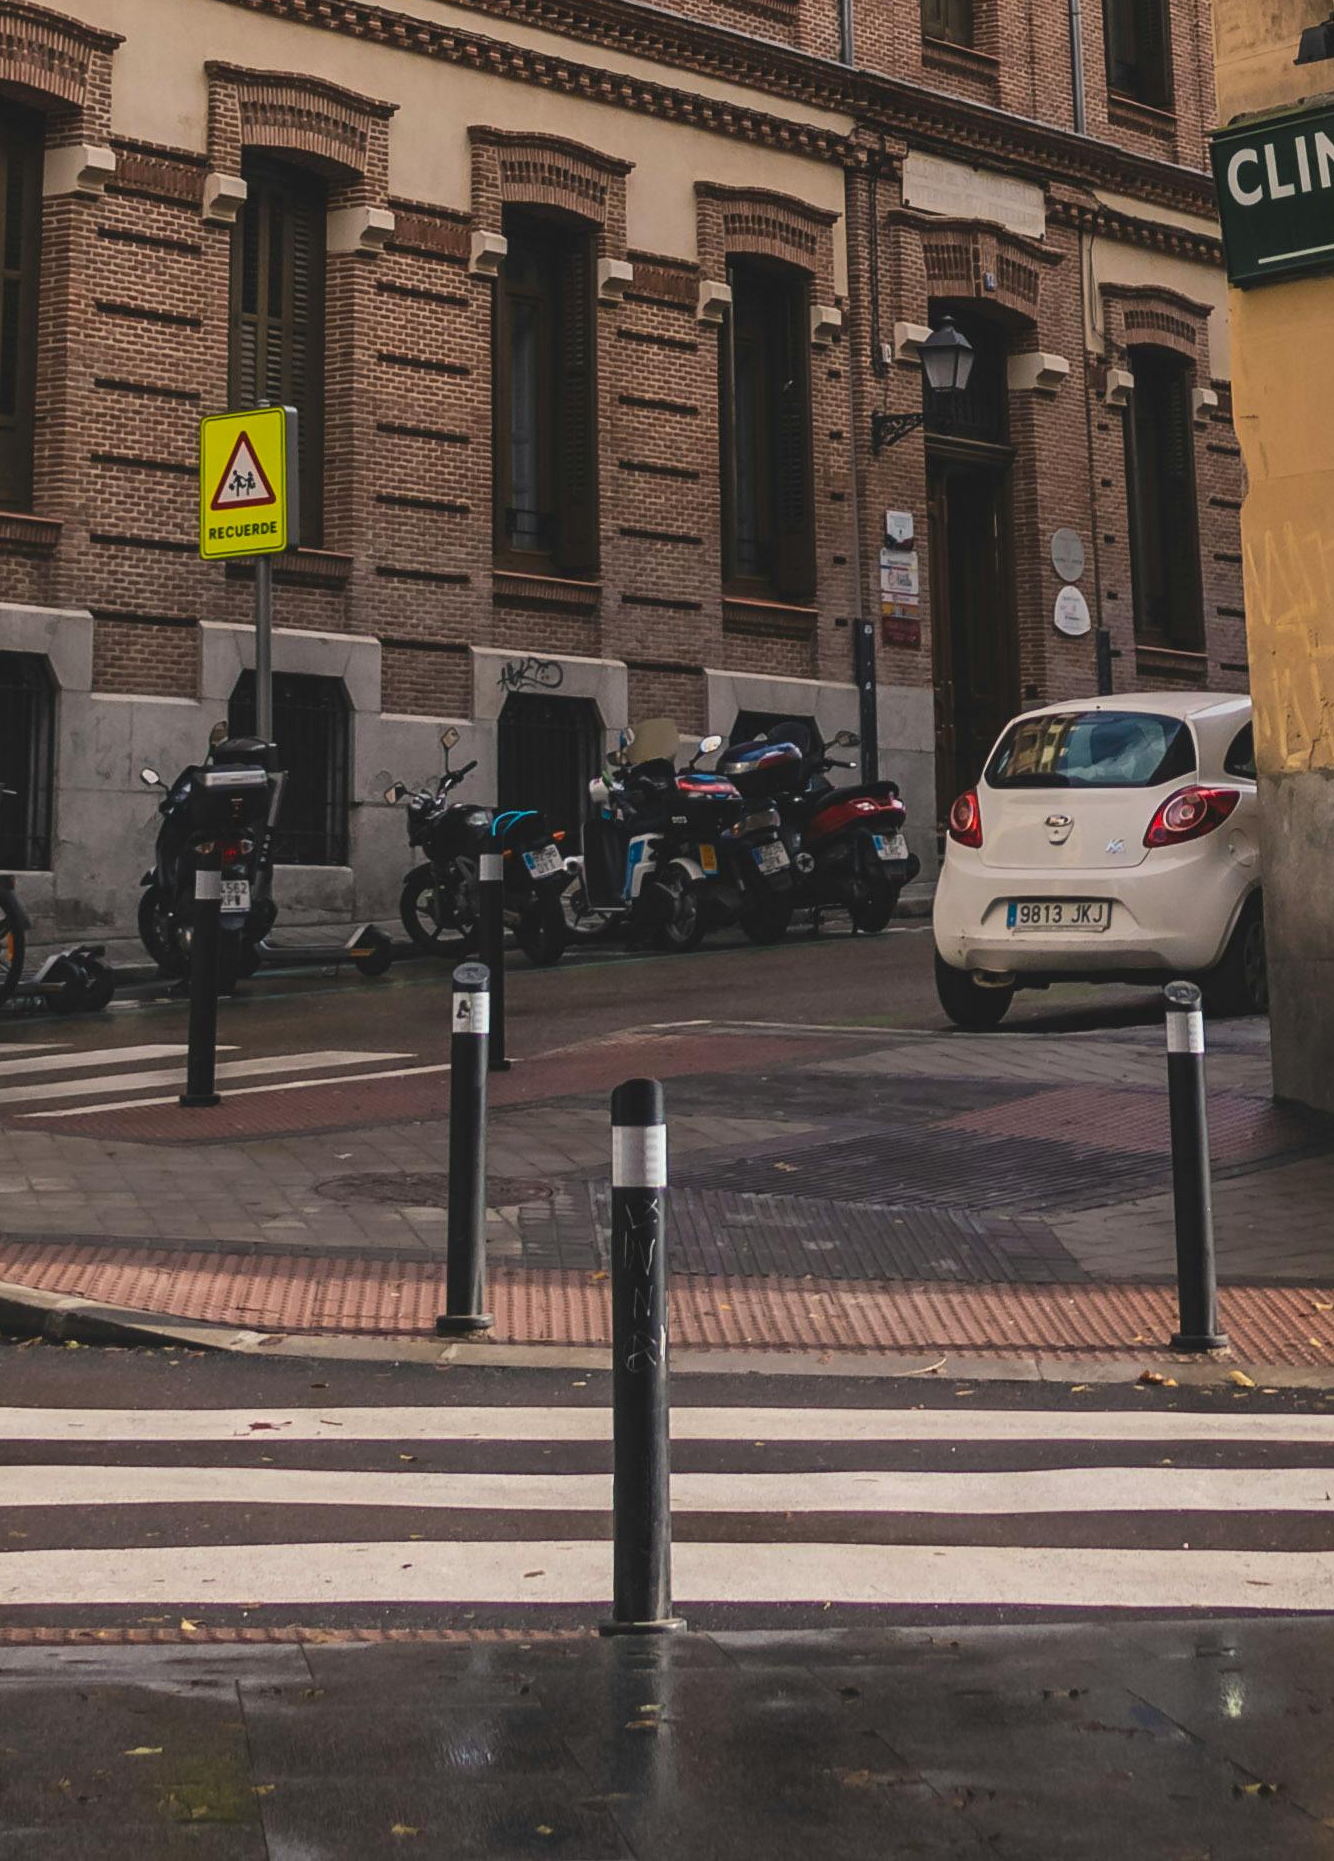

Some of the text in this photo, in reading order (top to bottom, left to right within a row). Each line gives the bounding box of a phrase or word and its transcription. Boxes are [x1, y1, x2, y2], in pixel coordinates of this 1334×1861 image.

[208, 521, 278, 540] RECUERDE
[1020, 904, 1103, 924] 9813 JKJ
